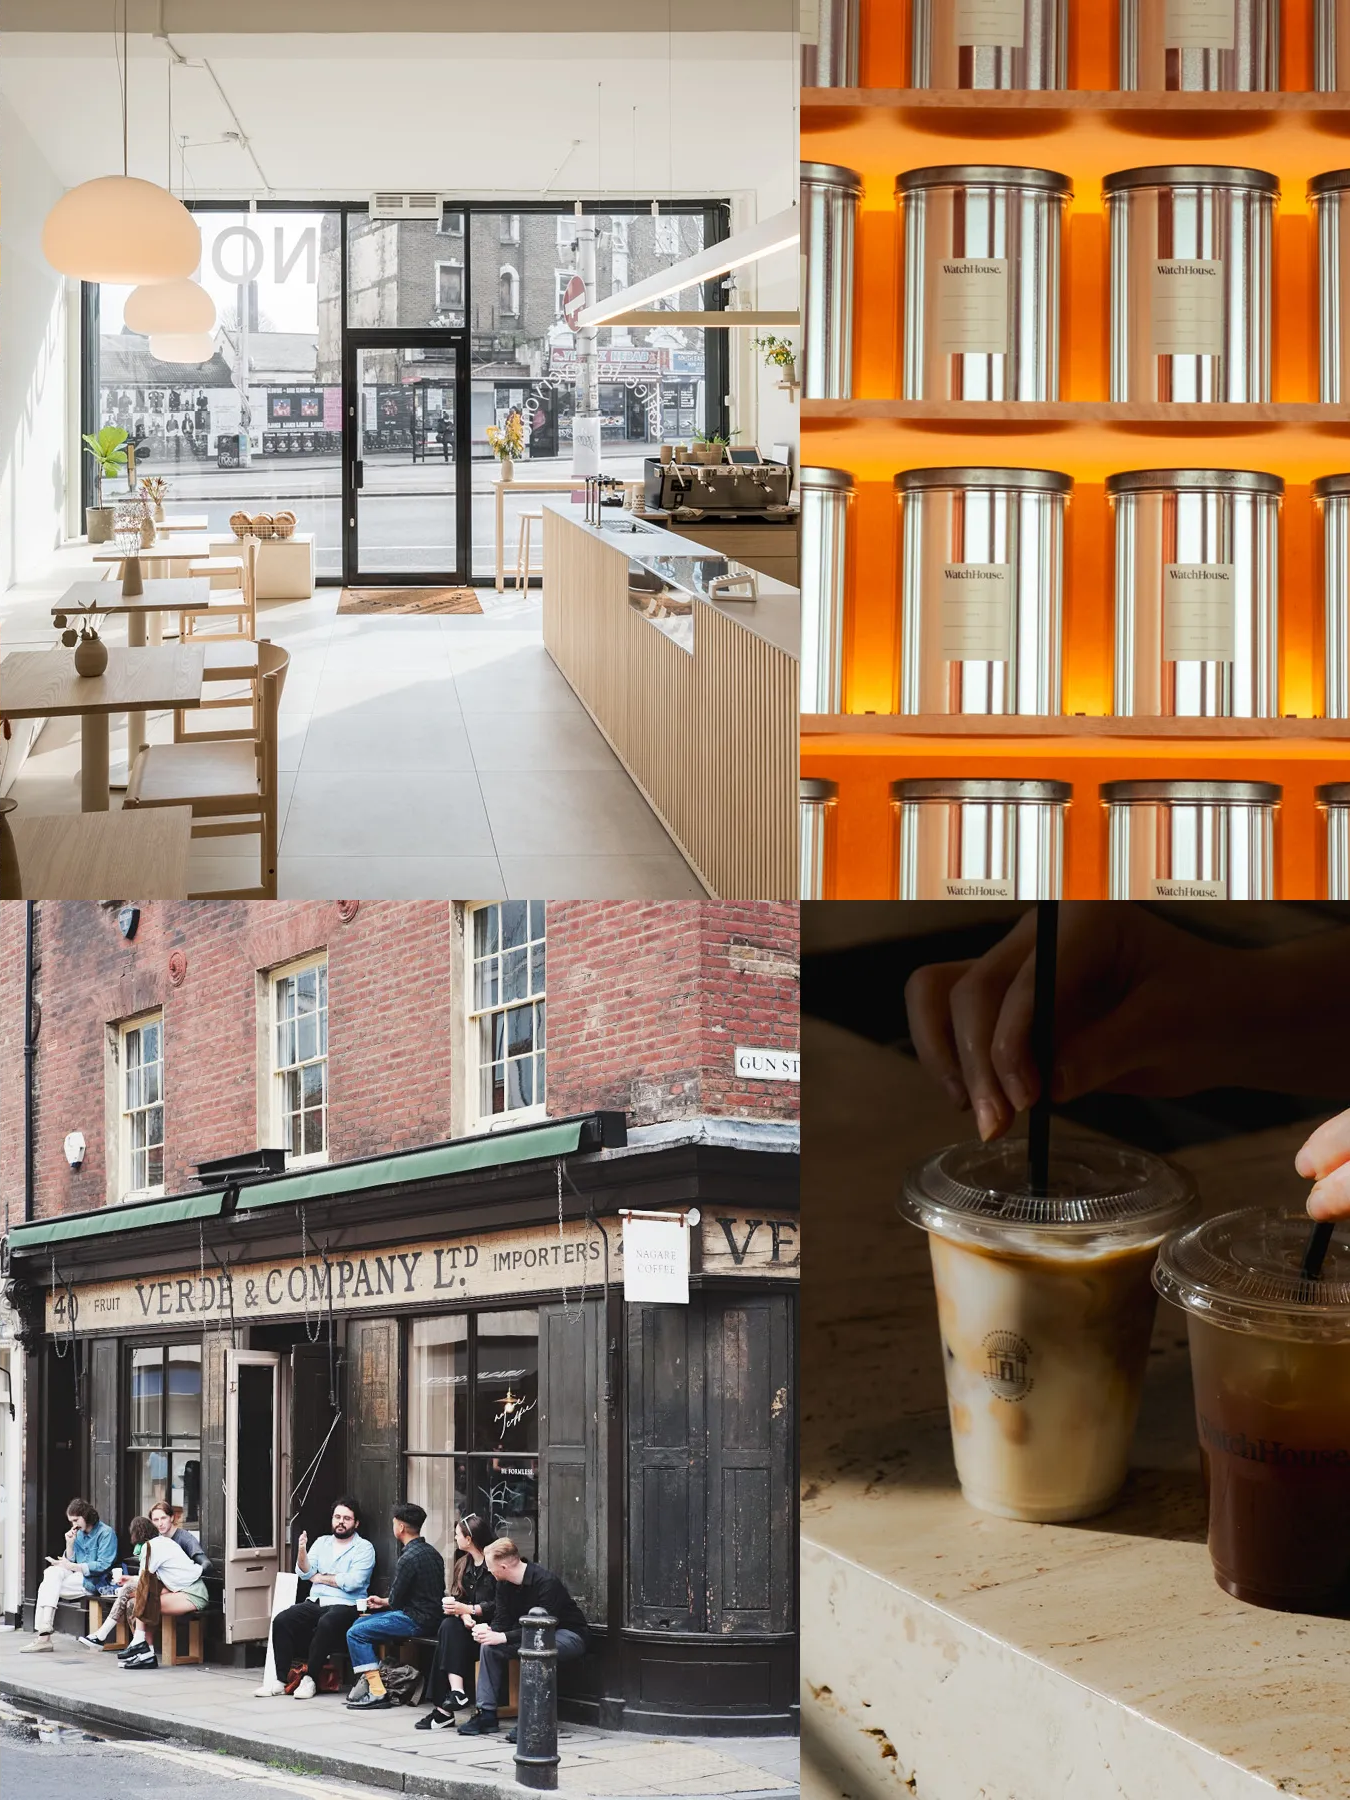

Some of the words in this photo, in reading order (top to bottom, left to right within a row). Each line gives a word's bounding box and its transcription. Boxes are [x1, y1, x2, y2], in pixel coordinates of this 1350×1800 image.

[943, 264, 1002, 274] WatchHouse.
[1157, 264, 1216, 275] WatchHouse.
[944, 569, 1004, 580] WatchHouse.
[1170, 569, 1230, 580] WatchHouse.
[946, 885, 1008, 896] WatchHouse.
[1156, 885, 1217, 898] WatchHouse.
[740, 1056, 777, 1071] GUN
[636, 1249, 677, 1260] NAGARE
[637, 1263, 676, 1275] COFFEE
[54, 1293, 79, 1325] 40
[94, 1297, 120, 1313] FRUIT
[135, 1275, 235, 1317] VERDE
[245, 1279, 259, 1308] &
[265, 1251, 423, 1306] COMPANY
[493, 1240, 600, 1273] IMPORTERS
